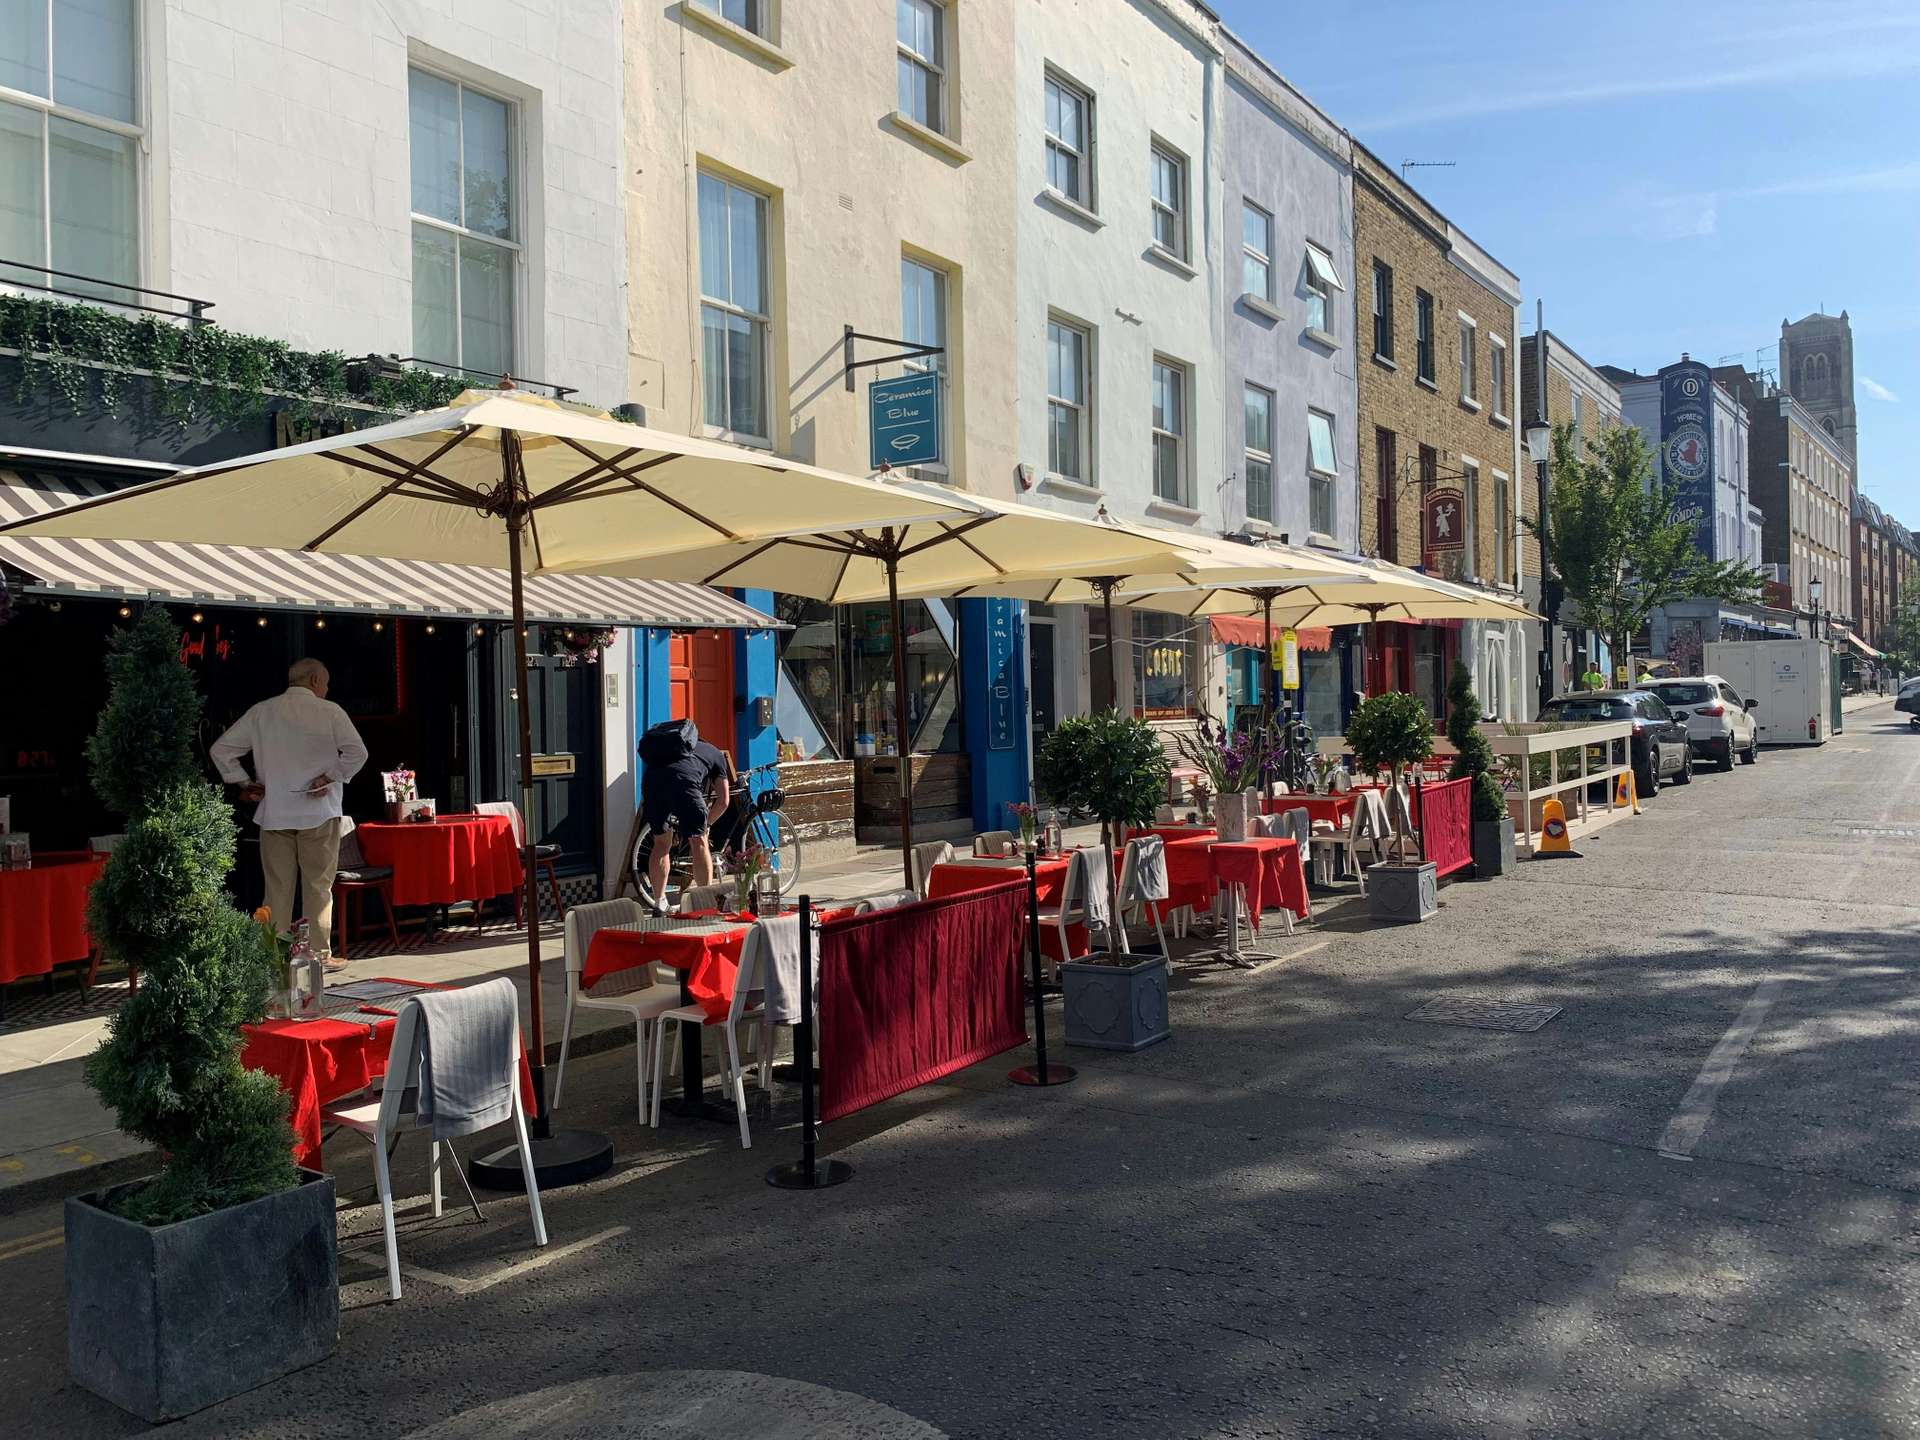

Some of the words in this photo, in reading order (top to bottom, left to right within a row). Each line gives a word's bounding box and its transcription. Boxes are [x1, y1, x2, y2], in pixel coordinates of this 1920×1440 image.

[874, 387, 932, 403] Ceramica
[886, 407, 920, 419] Blue
[994, 598, 1007, 679] ramica
[993, 685, 1010, 740] Blue
